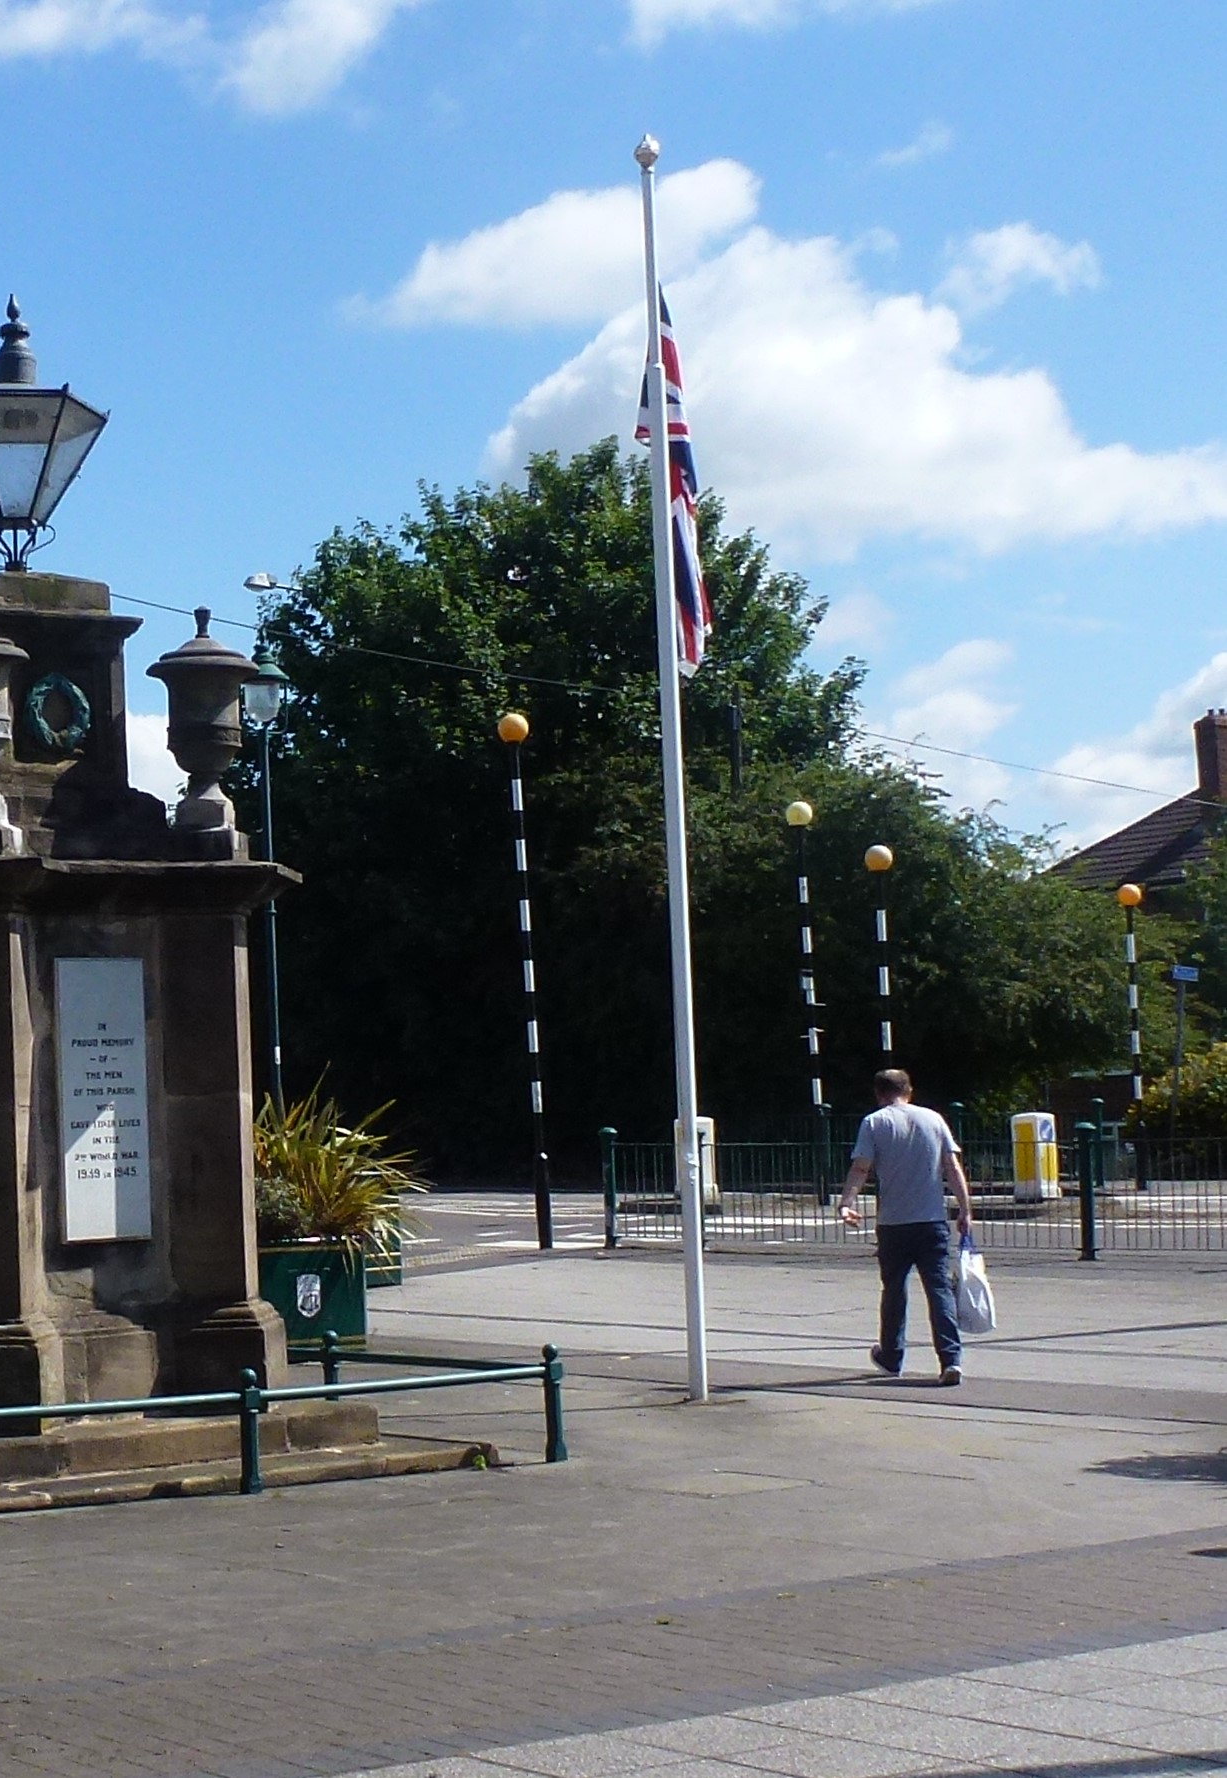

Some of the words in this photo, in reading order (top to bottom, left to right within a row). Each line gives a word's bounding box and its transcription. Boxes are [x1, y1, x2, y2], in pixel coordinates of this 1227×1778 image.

[71, 1038, 98, 1047] PROUD
[101, 1037, 135, 1047] MEMORY
[86, 1072, 101, 1080] THE
[104, 1071, 123, 1079] MEN
[73, 1088, 84, 1097] OF
[86, 1088, 104, 1096] THIS
[95, 1104, 115, 1112] WHO
[70, 1120, 90, 1130] GAVE
[118, 1119, 141, 1128] LIVES
[92, 1136, 102, 1144] IN
[103, 1135, 120, 1144] THE
[89, 1152, 118, 1160] WORLD
[77, 1168, 101, 1180] 1939
